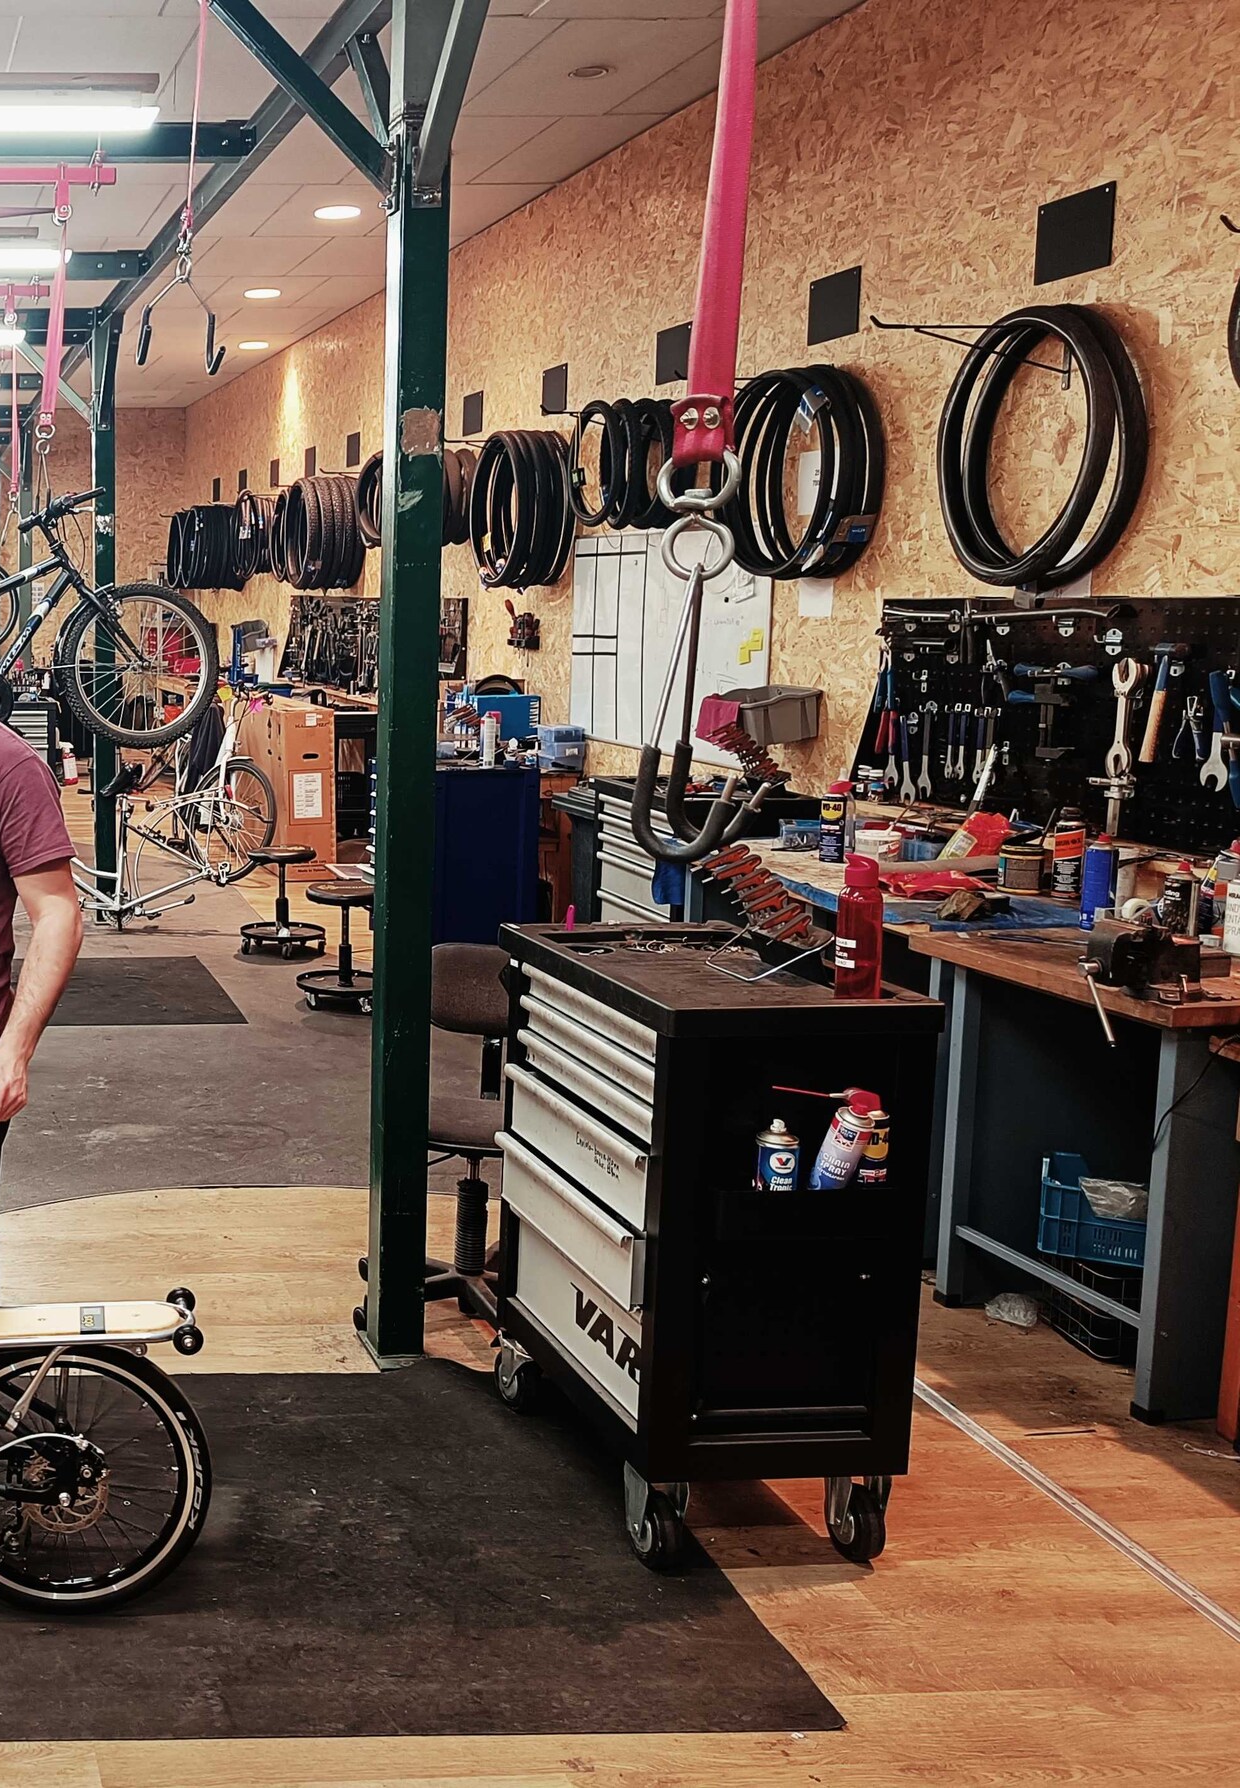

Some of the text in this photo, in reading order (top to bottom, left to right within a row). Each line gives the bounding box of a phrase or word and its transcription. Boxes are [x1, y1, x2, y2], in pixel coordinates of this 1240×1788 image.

[820, 1160, 847, 1176] SPRAY
[823, 1152, 850, 1168] CHAIN
[771, 1176, 793, 1185] Clean
[570, 1282, 641, 1386] VAR
